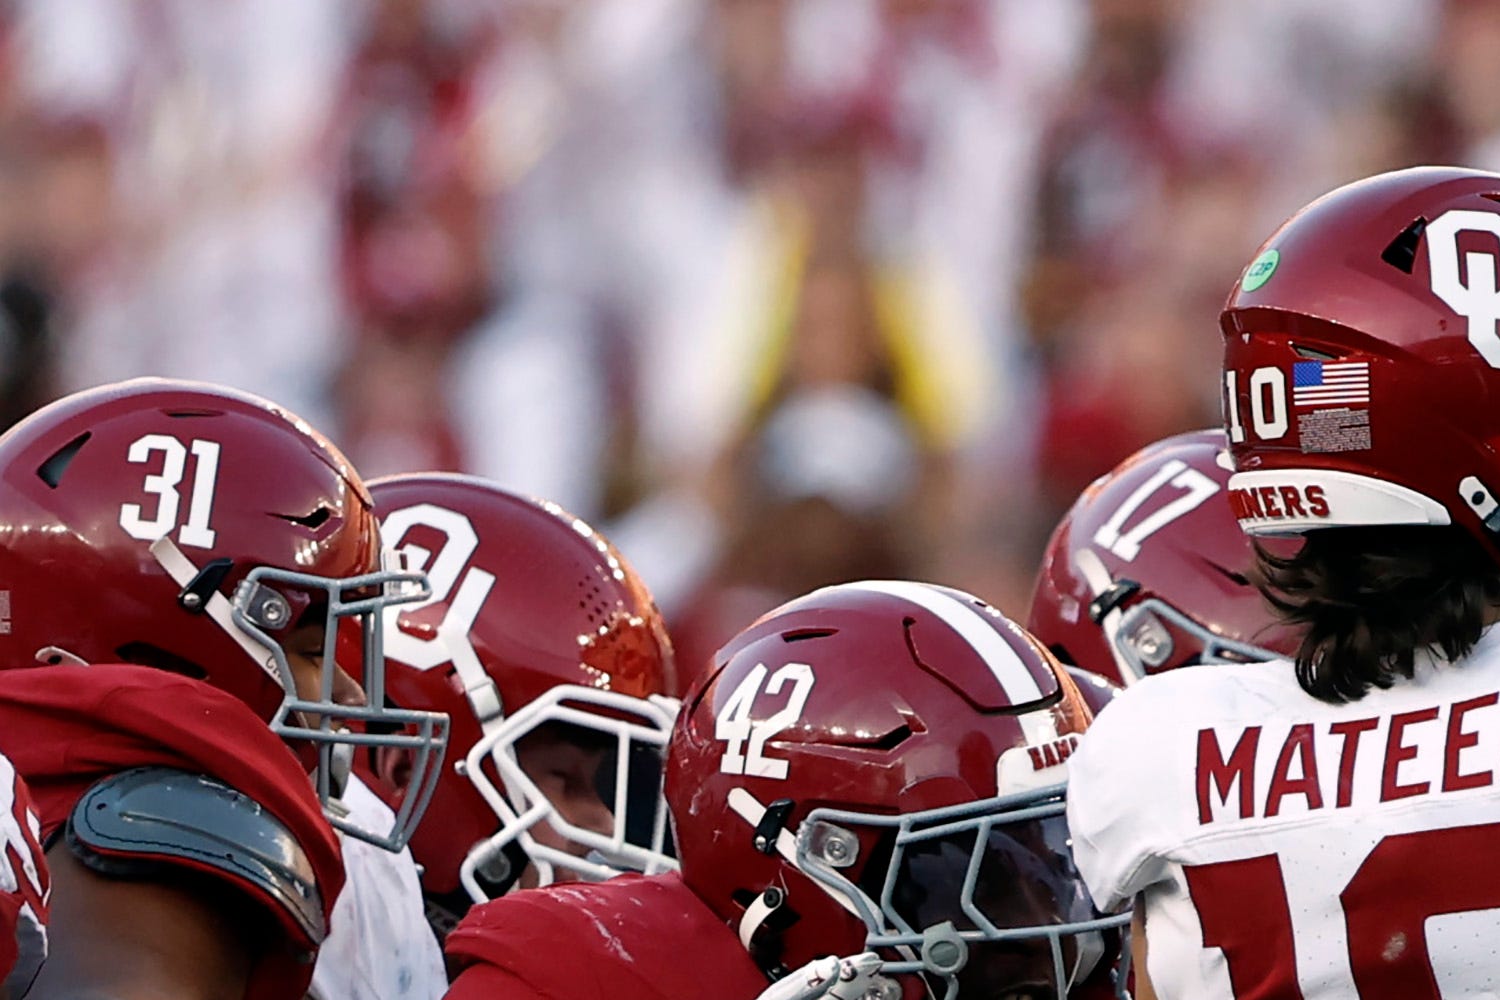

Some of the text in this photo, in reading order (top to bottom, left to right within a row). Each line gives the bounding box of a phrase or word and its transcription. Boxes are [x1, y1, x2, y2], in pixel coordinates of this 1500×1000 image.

[1226, 366, 1289, 443] 10
[119, 434, 220, 549] 31
[1093, 459, 1220, 562] 17
[1228, 485, 1331, 519] NERS
[715, 663, 815, 780] 42
